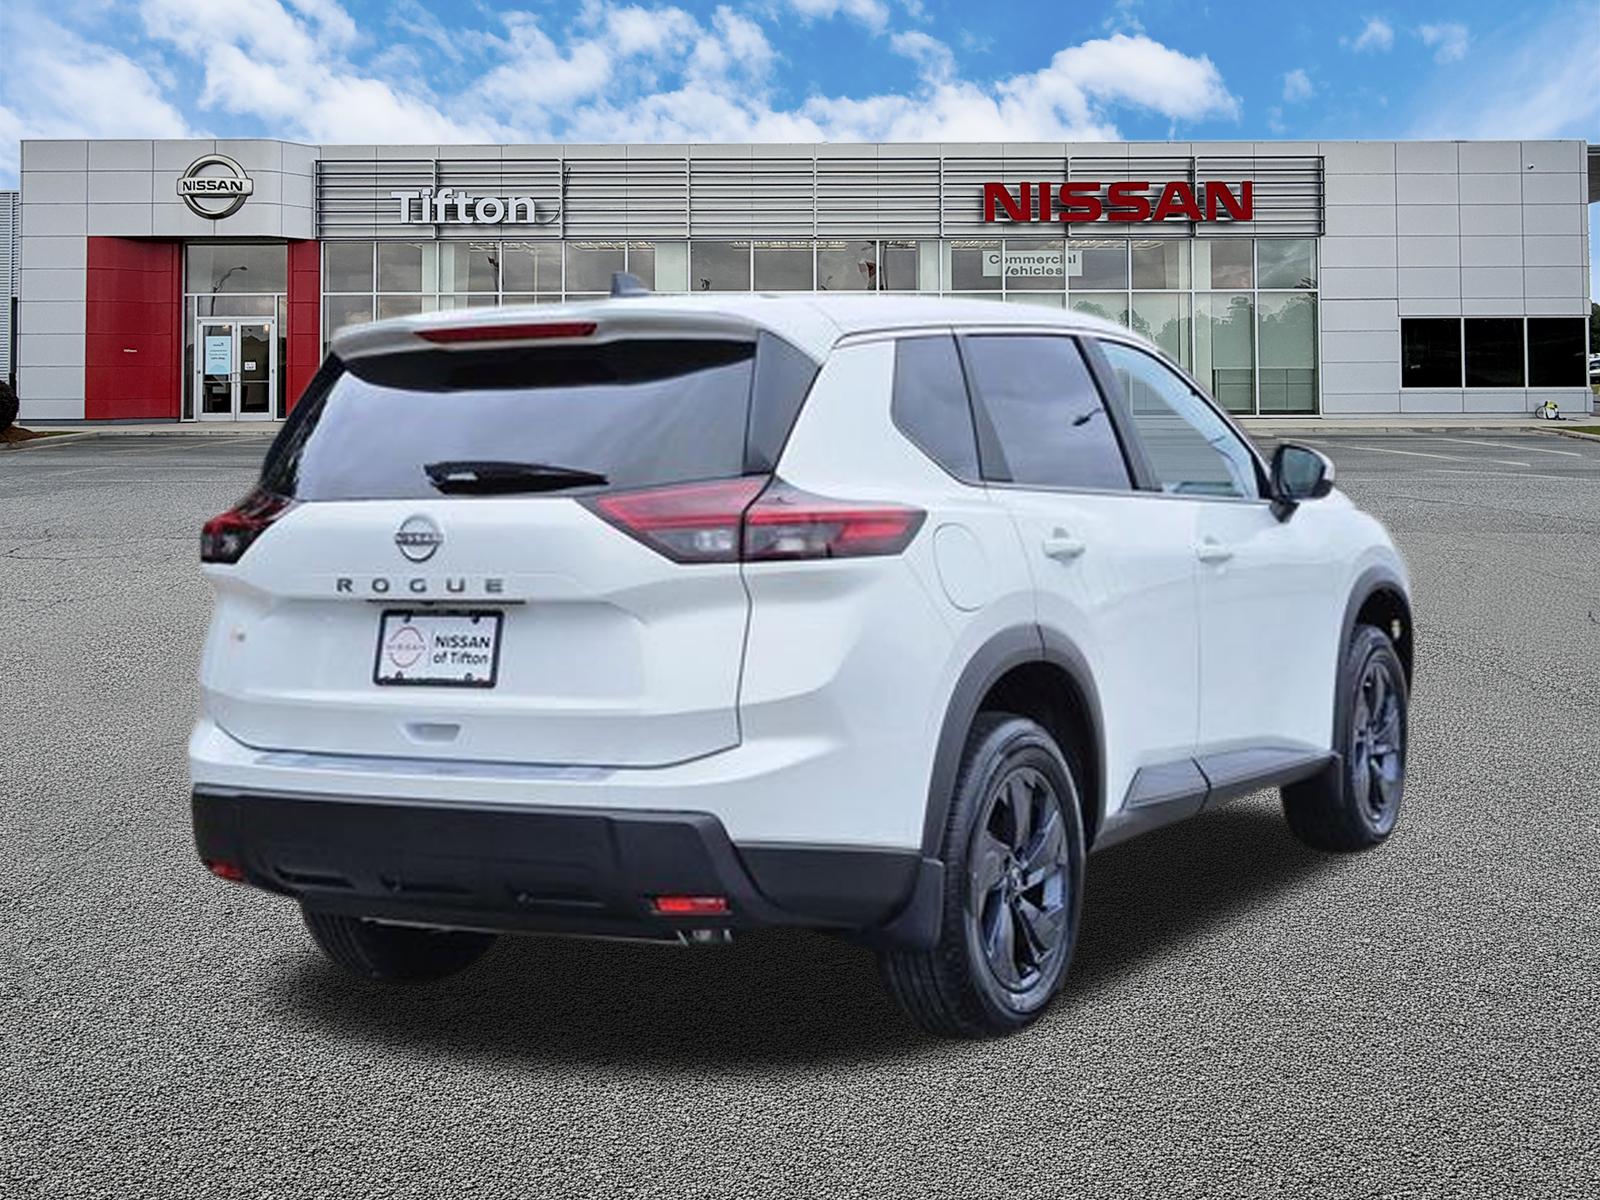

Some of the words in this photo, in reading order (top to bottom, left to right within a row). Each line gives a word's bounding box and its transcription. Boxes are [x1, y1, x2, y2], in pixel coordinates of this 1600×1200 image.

[182, 180, 243, 192] NISSAN
[390, 188, 537, 224] Tifton
[983, 181, 1254, 222] NISSAN
[336, 578, 504, 593] ROGUE
[435, 635, 490, 649] NISSAN
[433, 652, 447, 664] of
[450, 651, 488, 665] Tifton
